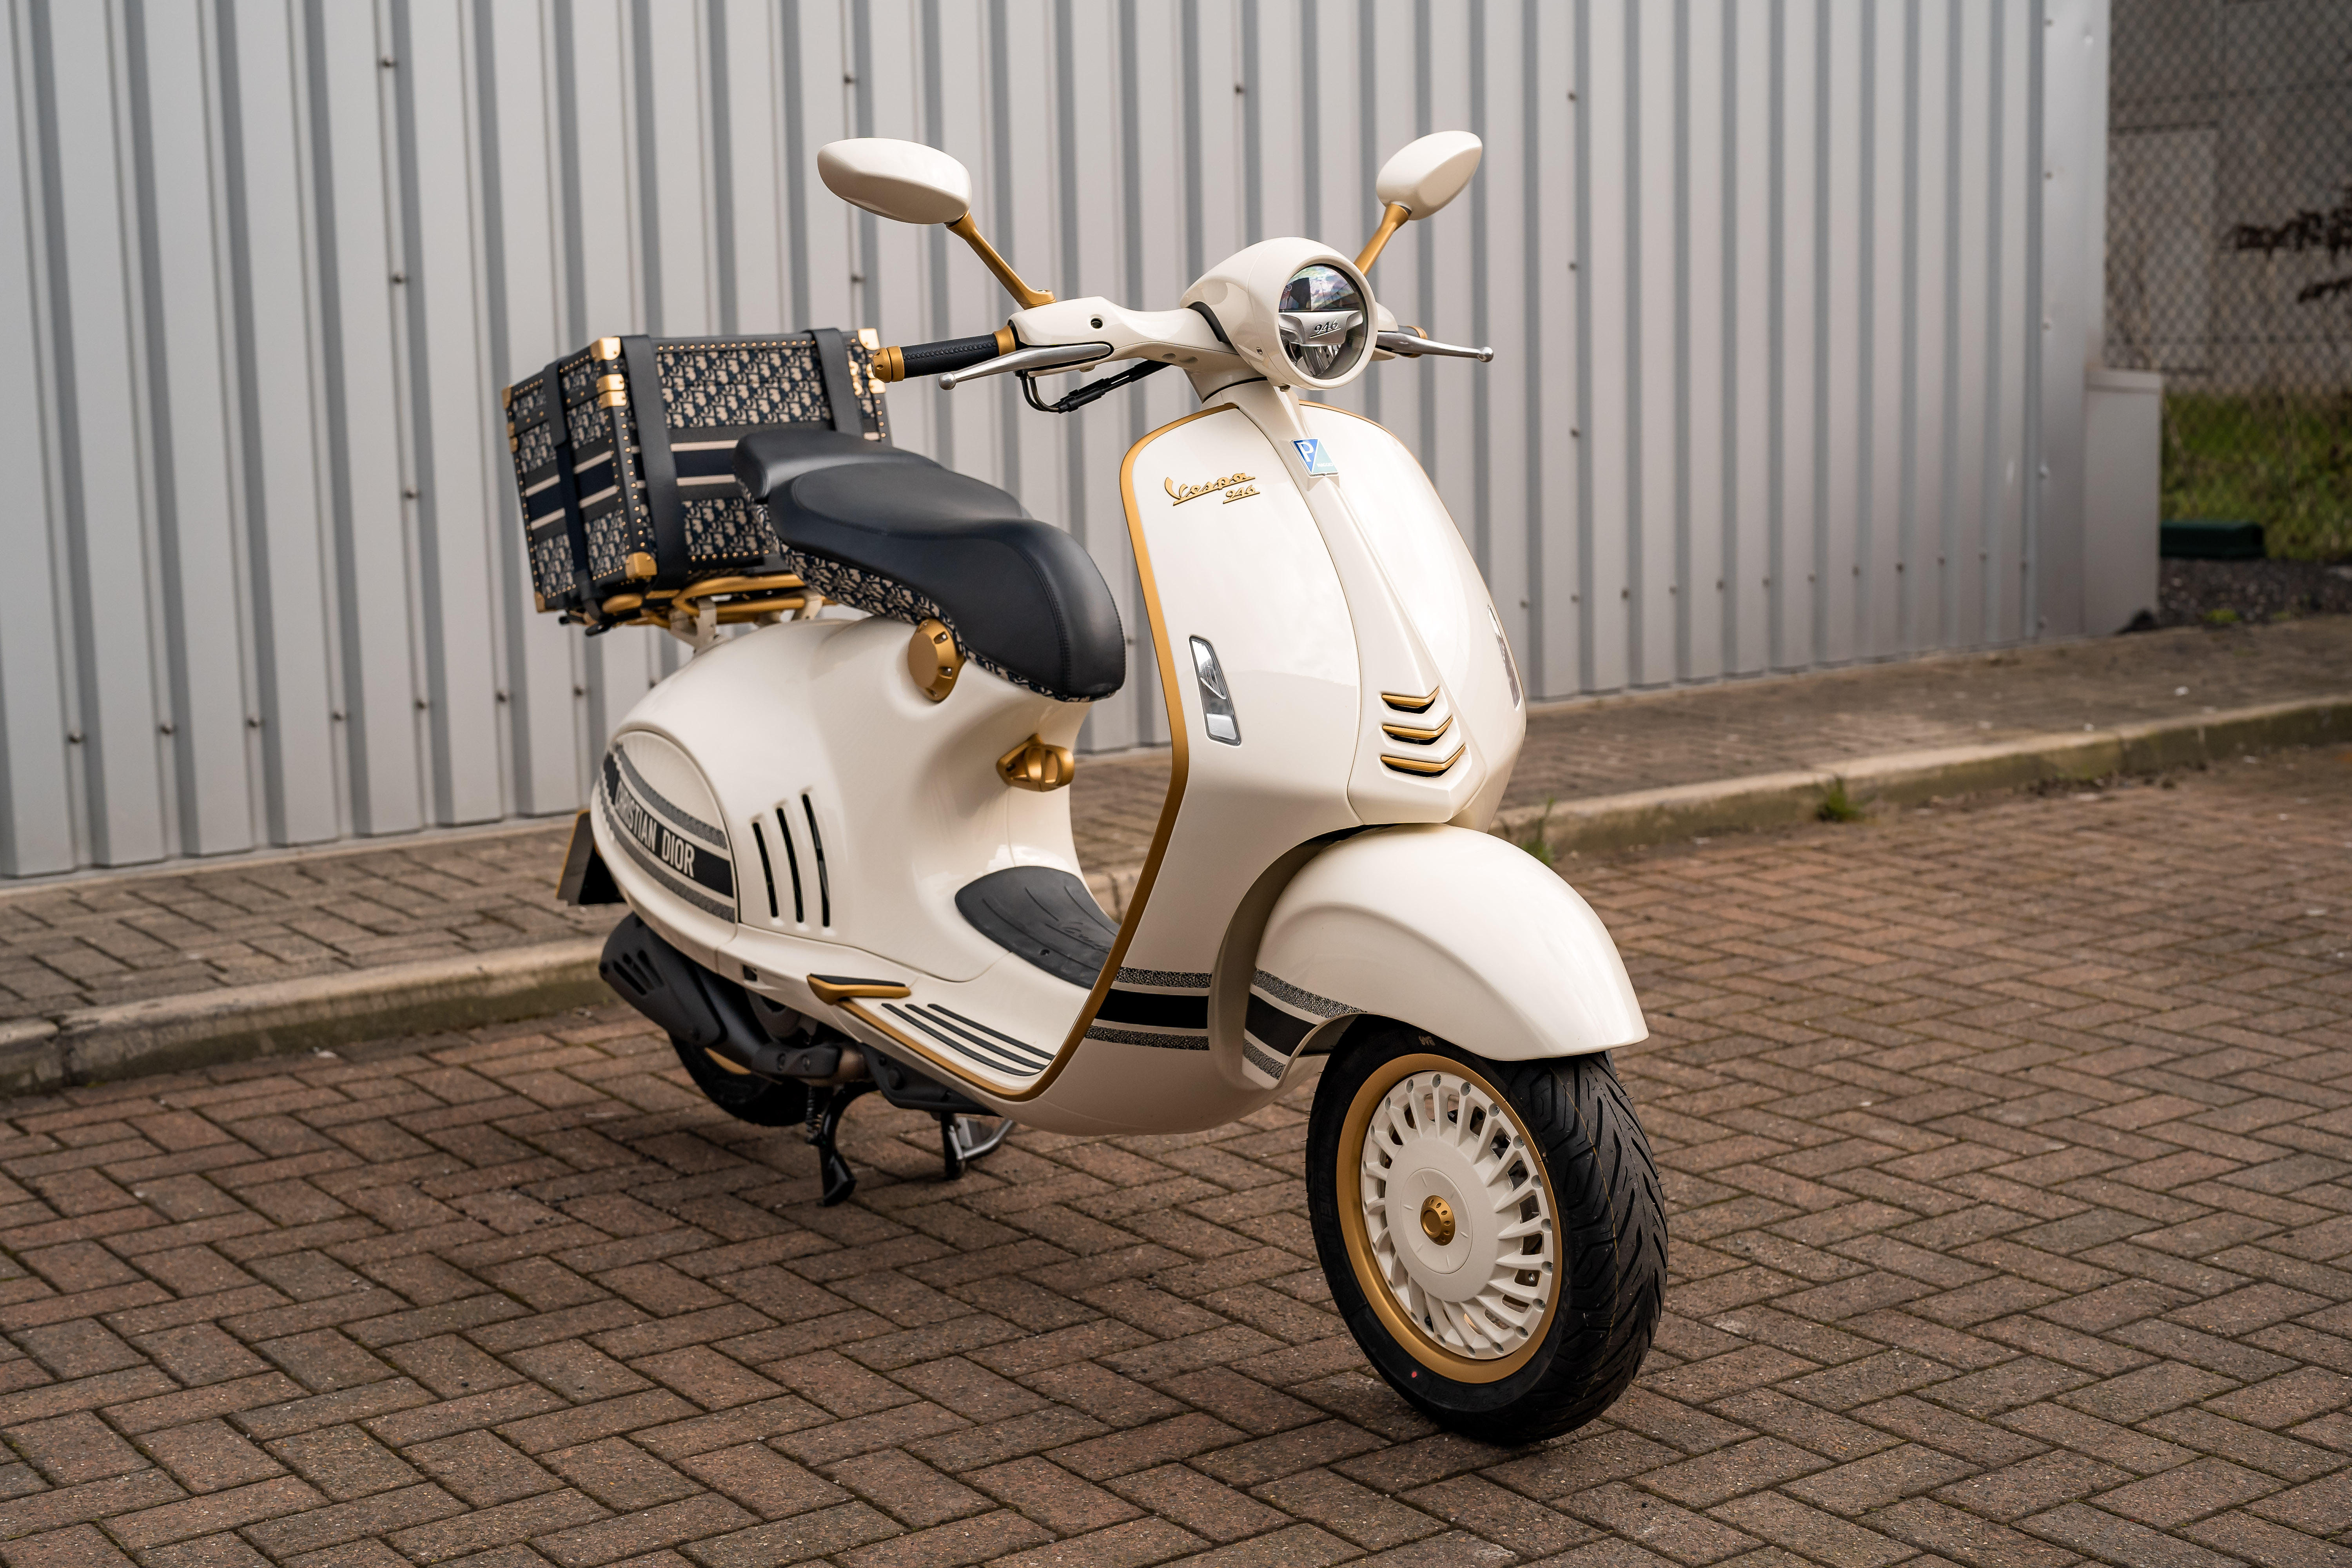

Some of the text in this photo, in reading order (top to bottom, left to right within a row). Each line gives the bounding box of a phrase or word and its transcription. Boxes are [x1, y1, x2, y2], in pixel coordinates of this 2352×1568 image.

[1312, 318, 1340, 336] 946
[1296, 441, 1314, 462] P
[1164, 473, 1255, 506] Vespa
[1224, 485, 1259, 503] 946
[661, 829, 695, 878] DIOR
